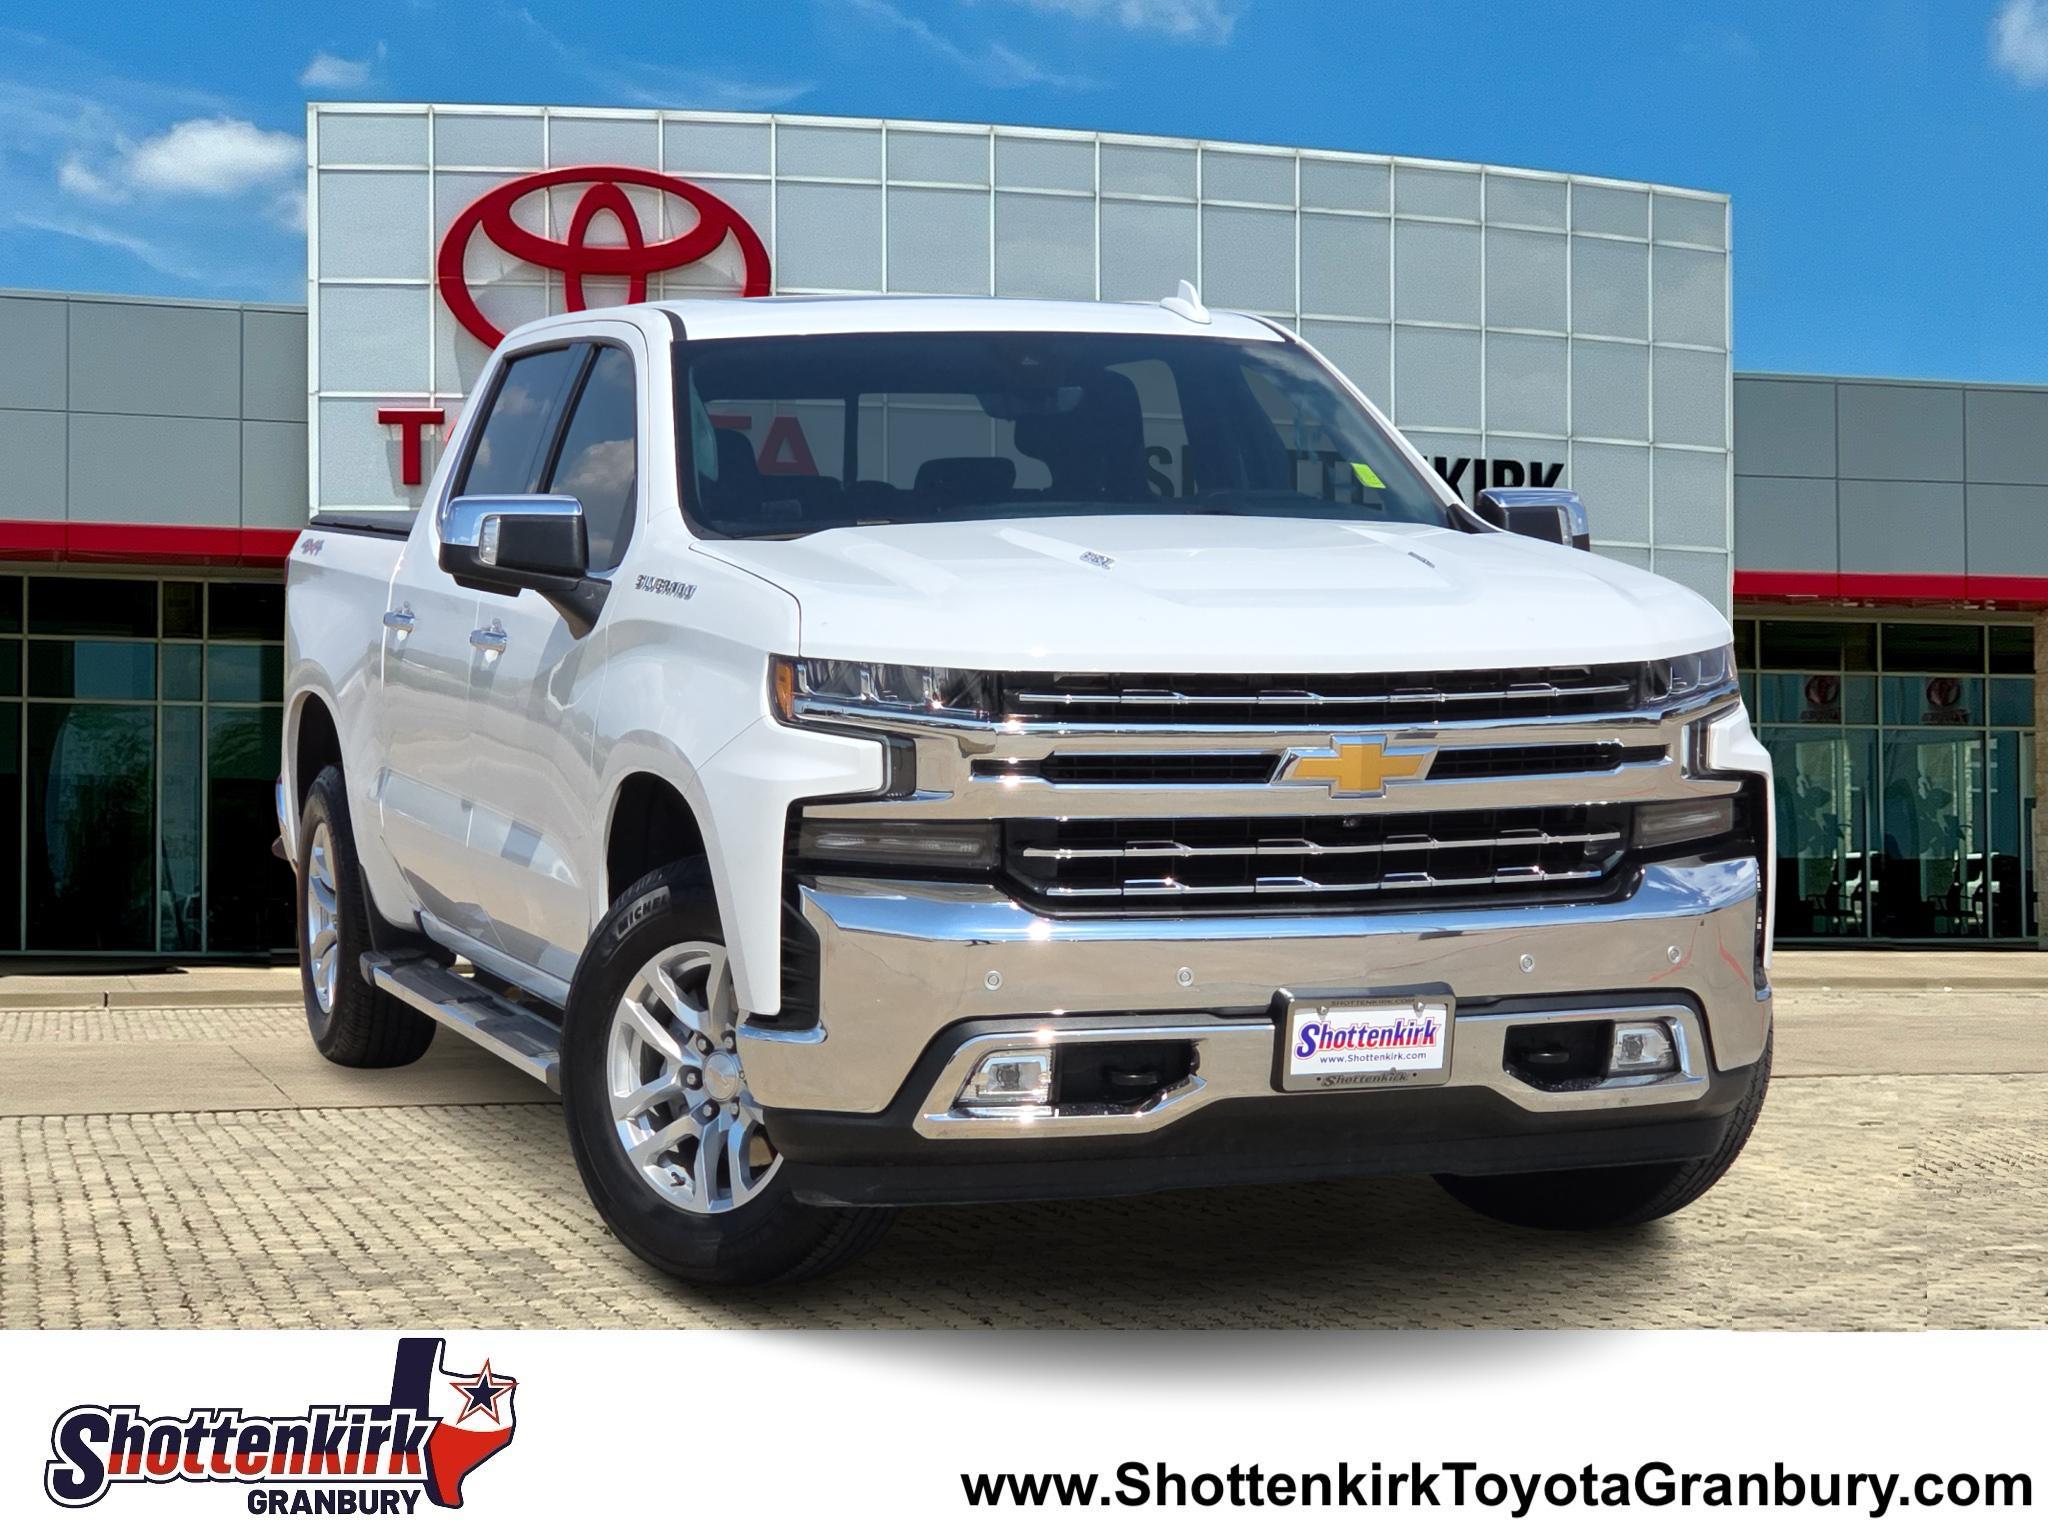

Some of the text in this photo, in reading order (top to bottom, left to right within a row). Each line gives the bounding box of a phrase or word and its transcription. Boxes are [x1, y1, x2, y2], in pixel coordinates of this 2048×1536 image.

[1296, 1017, 1438, 1059] Shottenkirk
[1320, 1052, 1427, 1064] www.Shottenkirk.com
[1321, 1072, 1408, 1087] Shottenkirk
